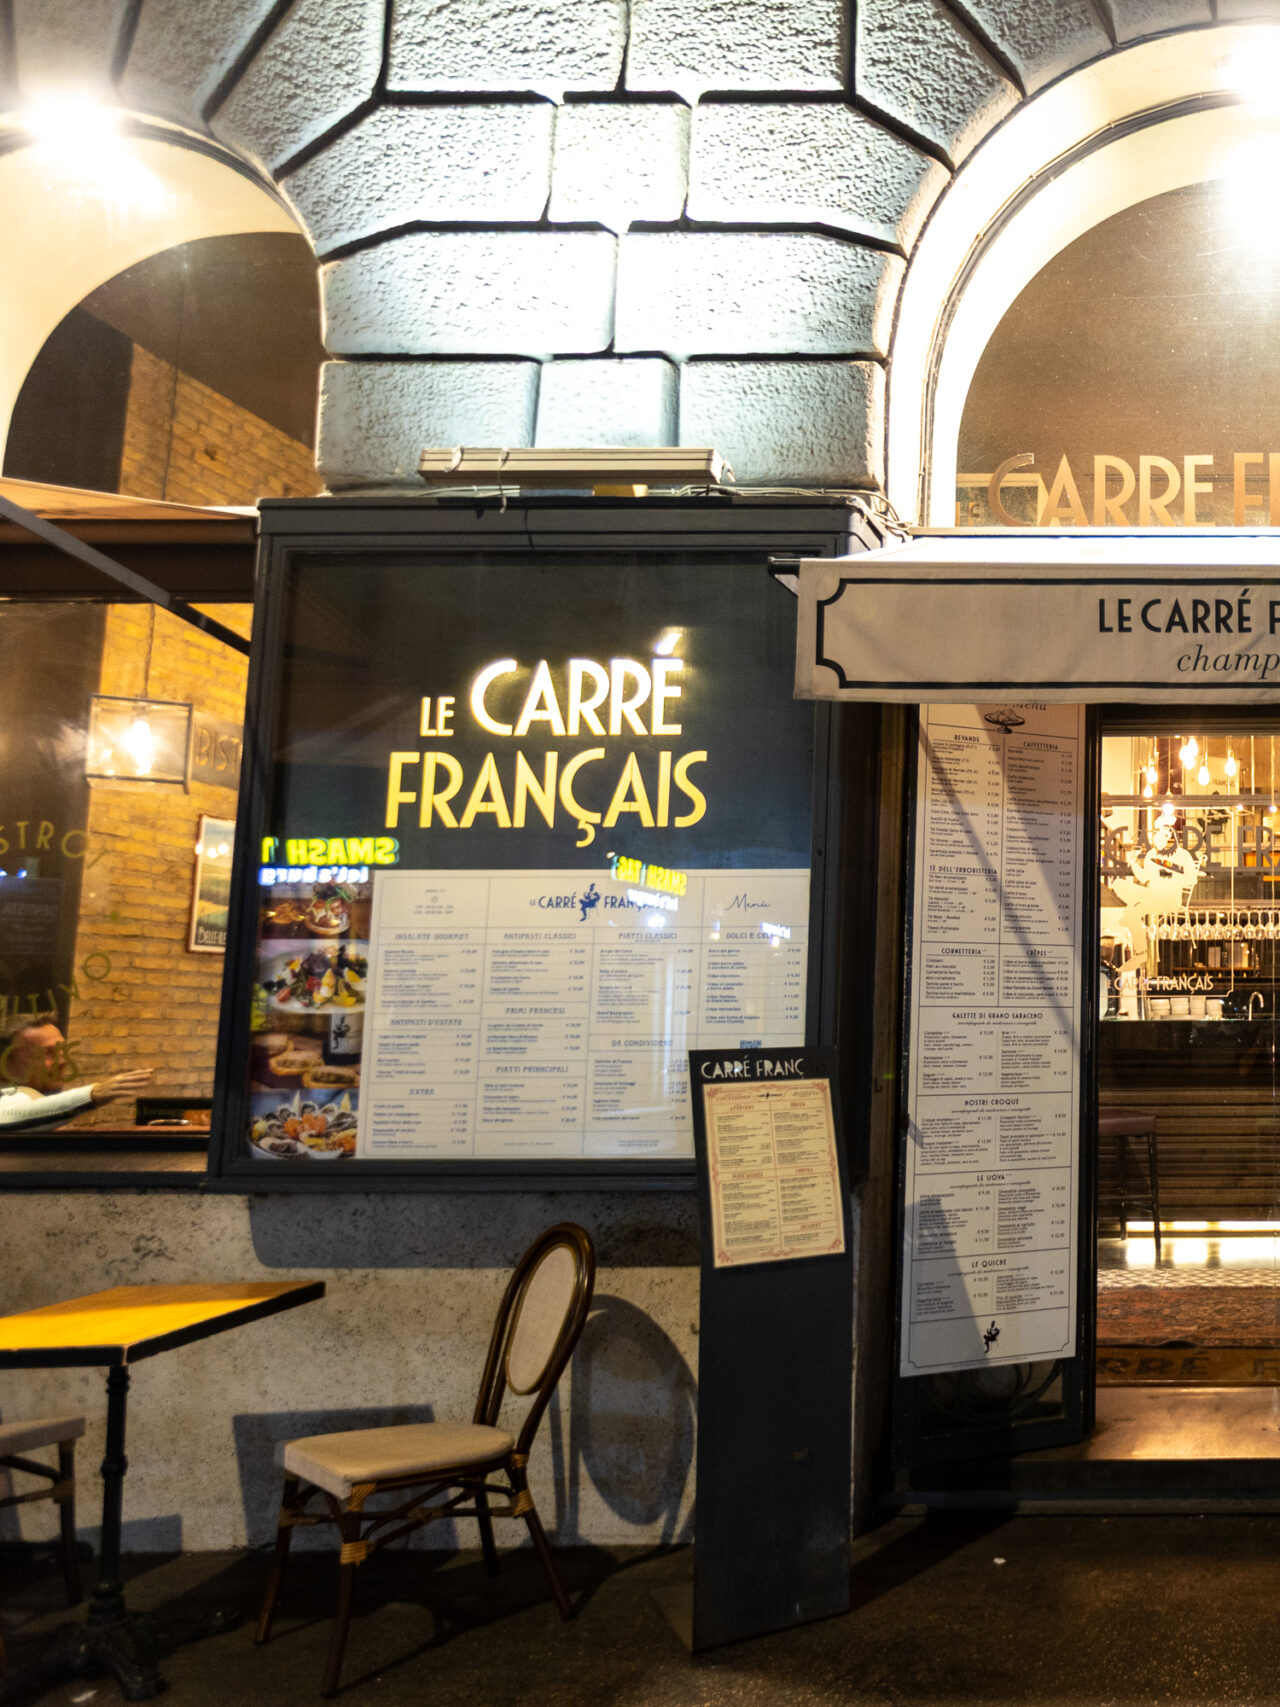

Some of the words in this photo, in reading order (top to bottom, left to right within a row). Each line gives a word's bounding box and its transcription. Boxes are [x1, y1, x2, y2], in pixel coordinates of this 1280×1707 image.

[1098, 597, 1133, 633] LE
[1140, 588, 1253, 635] CARRÉ
[420, 696, 456, 737] LE
[469, 632, 684, 738] CARRÉ
[385, 746, 709, 849] FRANÇAIS
[538, 891, 577, 909] CARRÉ
[1156, 975, 1214, 994] FRANÇAIS
[952, 1012, 977, 1020] GALETTE
[988, 1012, 1010, 1020] GRANO
[1012, 1012, 1043, 1020] SARACENO
[701, 1055, 752, 1079] CARRÉ
[756, 1057, 805, 1081] FRANÇ
[990, 1098, 1020, 1106] CROQUE
[976, 1174, 985, 1182] LE
[986, 1174, 1006, 1182] UOVA
